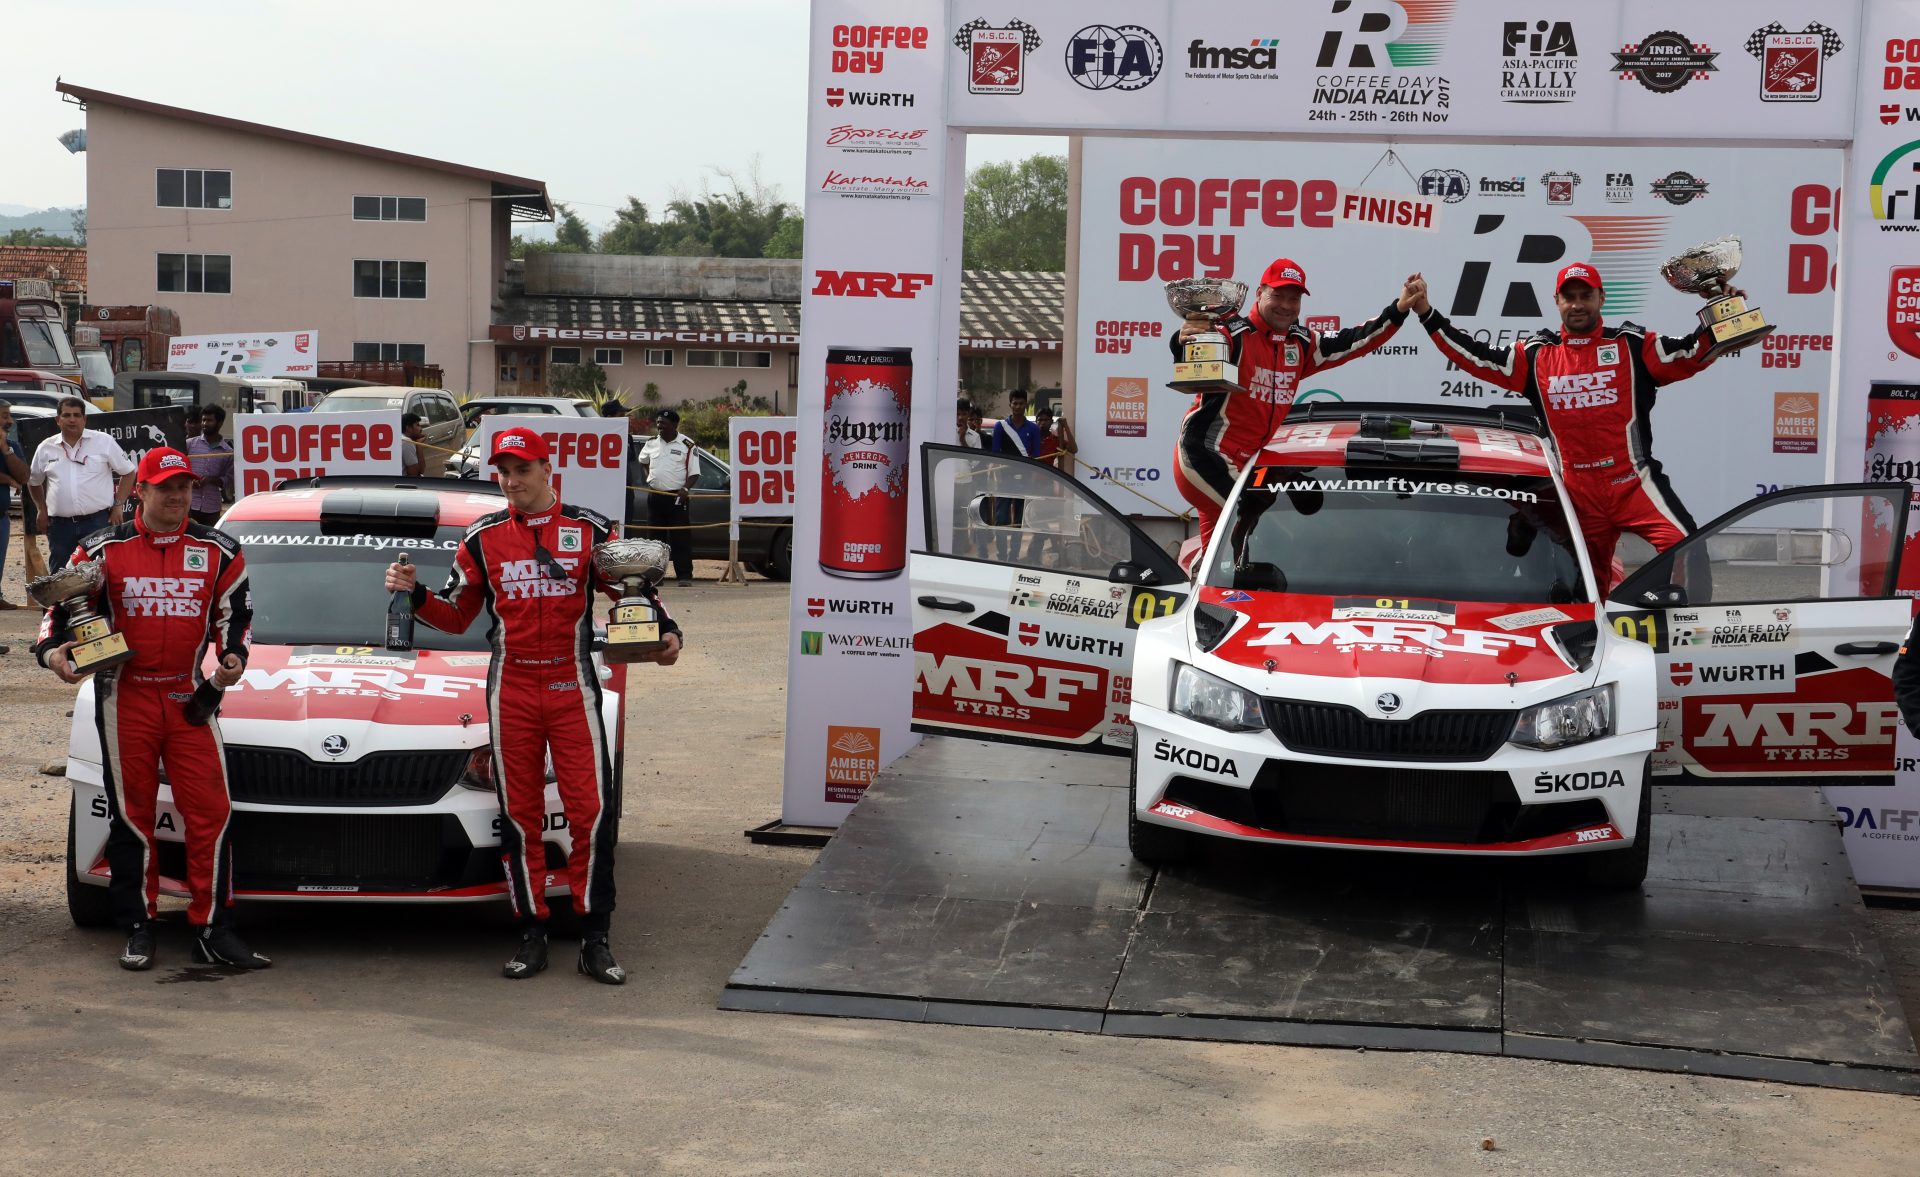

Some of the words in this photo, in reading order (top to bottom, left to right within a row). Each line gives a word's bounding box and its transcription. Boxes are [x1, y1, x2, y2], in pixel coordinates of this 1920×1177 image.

[1187, 39, 1280, 70] fmsci
[1649, 46, 1682, 55] INRC
[1502, 59, 1578, 69] ASIA-PACIFIC
[1316, 75, 1392, 88] COFFEE
[1397, 76, 1436, 88] DAY
[1501, 71, 1577, 88] RALLY
[1884, 67, 1920, 91] Da
[849, 92, 914, 107] WÜRTH
[1312, 88, 1367, 104] INDIA
[1371, 89, 1434, 105] RALLY
[1437, 77, 1450, 108] 2017
[1309, 110, 1337, 122] 24th
[1349, 110, 1378, 122] 25th
[1390, 110, 1418, 122] 26th
[1422, 111, 1449, 123] Nov
[821, 170, 929, 189] Karnataka
[1479, 177, 1526, 192] fmsci
[1343, 194, 1433, 228] FINISH
[811, 270, 933, 299] MRF
[286, 364, 314, 372] MRF
[1251, 365, 1297, 389] MRF
[1547, 369, 1617, 394] MRF
[1440, 380, 1484, 398] 24th
[1890, 389, 1909, 397] BOLT
[1109, 401, 1145, 410] AMBER
[1547, 388, 1619, 410] TYRES
[1109, 411, 1145, 420] VALLEY
[1776, 417, 1816, 426] AMBER
[125, 425, 137, 439] BY
[1776, 426, 1816, 435] VALLEY
[738, 430, 797, 466] COF
[852, 462, 878, 470] DRINK
[1253, 467, 1268, 487] 1
[1267, 476, 1538, 504] www.mrftyres.com
[527, 515, 552, 526] MRF
[153, 535, 180, 544] MRF
[238, 533, 463, 551] www.mrftyres.c
[121, 576, 205, 598] MRF
[1018, 573, 1041, 585] fmsci
[501, 577, 578, 600] TYRES
[121, 598, 203, 617] TYRES
[828, 599, 893, 615] WÜRTH
[1046, 600, 1079, 614] INDIA
[1082, 605, 1119, 619] RALLY
[1050, 592, 1098, 607] COFFEE
[1098, 599, 1123, 610] DAY
[1132, 592, 1177, 625] 01
[1375, 598, 1409, 609] 01
[1612, 614, 1657, 648] 01
[1713, 624, 1763, 635] COFFEE
[1767, 623, 1793, 633] DAY
[828, 633, 914, 649] WAY2WEALTH
[1045, 631, 1124, 658] WÜRTH
[1247, 621, 1537, 656] MRF
[1711, 633, 1748, 645] INDIA
[1750, 631, 1791, 644] RALLY
[335, 646, 374, 656] 02
[1336, 643, 1445, 659] TYRES
[913, 651, 1099, 712] MRF
[1699, 664, 1785, 683] WÜRTH
[225, 666, 487, 699] MRF
[290, 687, 402, 701] TYRES
[954, 699, 1032, 721] TYRES
[1693, 701, 1899, 747] MRF
[1153, 738, 1239, 778] ŠKODA
[1764, 747, 1850, 760] TYRES
[829, 757, 875, 770] AMBER
[829, 769, 875, 782] VALLEY
[1534, 769, 1625, 794] ŠKODA
[827, 786, 857, 794] RESIDENTIAL
[1155, 802, 1194, 818] MRF
[1836, 806, 1920, 832] DAFF
[1576, 827, 1613, 842] MRF
[1869, 832, 1902, 841] COFFEE
[1904, 834, 1920, 842] DAY
